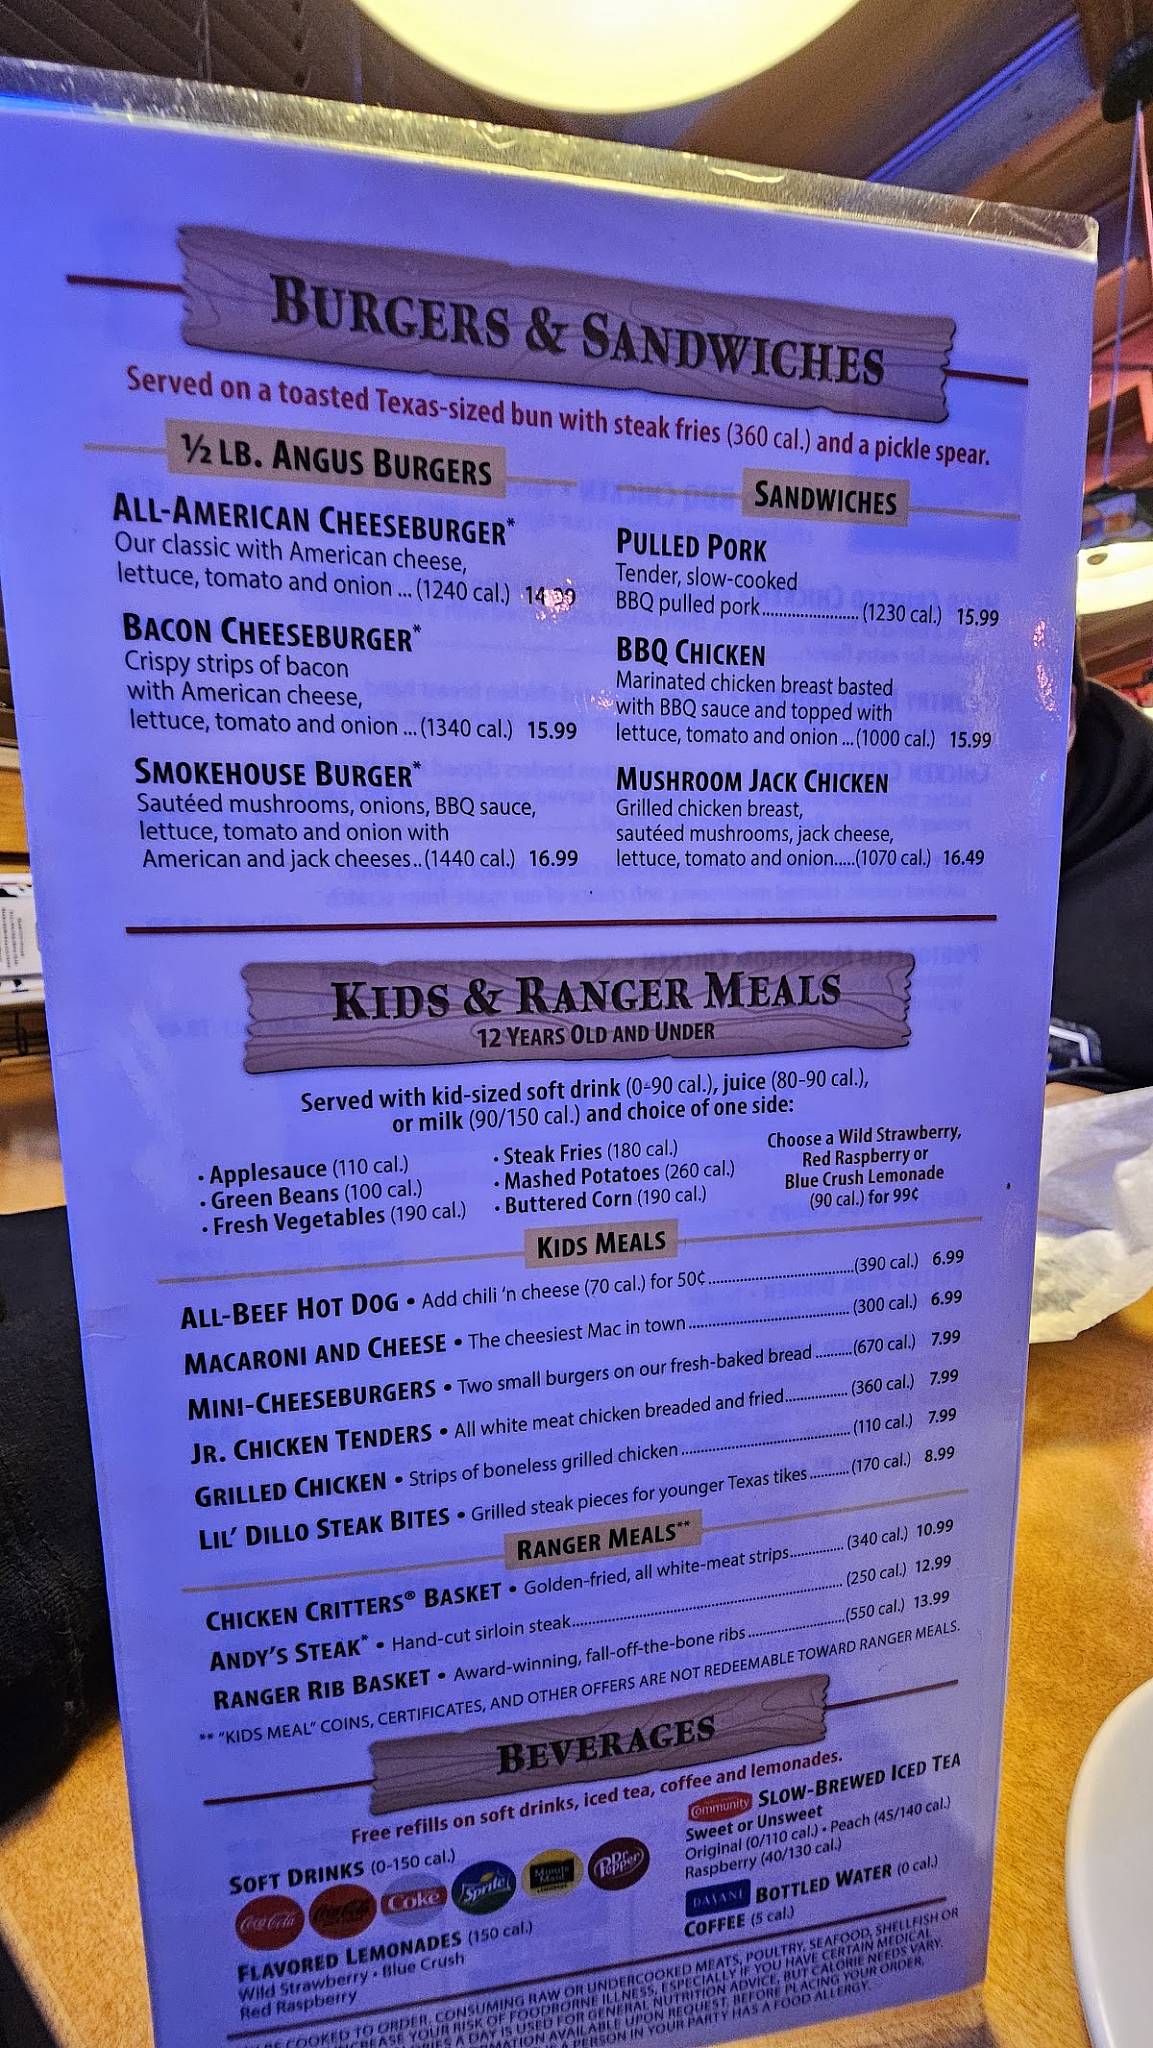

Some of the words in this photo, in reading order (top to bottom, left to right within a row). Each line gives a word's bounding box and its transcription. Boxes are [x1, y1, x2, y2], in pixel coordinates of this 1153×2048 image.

[270, 273, 509, 348] BURGERS
[526, 306, 566, 354] &
[582, 312, 885, 386] SANDWICHES
[127, 366, 212, 396] Served
[221, 380, 250, 400] on
[258, 383, 271, 402] a
[278, 381, 368, 410] toasted
[376, 388, 504, 424] Texas-sized
[512, 401, 552, 428] bun
[559, 408, 607, 433] with
[614, 415, 670, 439] steak
[675, 417, 720, 443] fries
[728, 422, 768, 448] (360
[774, 428, 810, 454] cal.)
[817, 432, 853, 454] and
[859, 439, 869, 455] a
[875, 436, 930, 461] pickle
[936, 445, 989, 467] spear.
[220, 439, 262, 468] LB.
[272, 440, 364, 475] ANGUS
[374, 448, 491, 486] BURGERS
[114, 492, 309, 532] ALL-AMERICAN
[755, 480, 896, 515] SANDWICHES
[618, 528, 699, 558] PULLED
[708, 534, 766, 562] PORK
[616, 563, 681, 588] Tender,
[687, 566, 797, 590] slow-cooked
[617, 590, 653, 612] BBQ
[660, 593, 714, 616] pulled
[863, 602, 905, 623] (1230
[911, 605, 941, 626] cal.)
[958, 608, 999, 626] 15.99
[123, 613, 211, 643] BACON
[618, 636, 668, 666] BBQ
[676, 639, 765, 666] CHICKEN
[617, 670, 705, 691] Marinated
[711, 673, 775, 692] chicken
[781, 674, 833, 694] breast
[838, 676, 892, 696] basted
[135, 757, 306, 786] SMOKEHOUSE
[617, 767, 742, 792] MUSHROOM
[748, 769, 797, 792] JACK
[804, 770, 888, 793] CHICKEN
[138, 793, 222, 812] Sautéed
[230, 793, 354, 816] mushrooms,
[360, 796, 430, 817] onions,
[436, 797, 474, 816] BBQ
[480, 802, 535, 818] sauce,
[331, 981, 449, 1021] KIDS
[464, 977, 501, 1017] &
[516, 976, 693, 1015] RANGER
[704, 971, 842, 1009] MEALS
[477, 1027, 501, 1048] 12
[507, 1025, 565, 1046] YEARS
[571, 1023, 607, 1045] OLD
[612, 1023, 649, 1043] AND
[655, 1021, 715, 1042] UNDER
[504, 1145, 555, 1165] Steak
[561, 1144, 602, 1162] Fries
[608, 1142, 641, 1161] (180
[646, 1139, 677, 1157] cal.)
[210, 1163, 326, 1184] Applesauce
[333, 1159, 368, 1178] (110
[374, 1155, 408, 1174] cal.)
[810, 1193, 832, 1210] (90
[836, 1190, 864, 1207] cal.)
[868, 1189, 889, 1204] for
[538, 1236, 587, 1259] KIDS
[596, 1231, 666, 1254] MEALS
[185, 1346, 306, 1375] MACARONI
[315, 1343, 360, 1364] AND
[368, 1334, 446, 1358] CHEESE
[468, 1332, 500, 1349] The
[505, 1325, 582, 1346] cheesiest
[588, 1322, 621, 1338] Mac
[626, 1320, 639, 1334] in
[854, 1297, 884, 1316] (300
[889, 1294, 917, 1310] cal.)
[932, 1290, 962, 1305] 6.99
[189, 1380, 436, 1420] MINI-CHEESEBURGERS
[457, 1378, 492, 1394] Two
[498, 1370, 540, 1390] small
[546, 1369, 609, 1387] burgers
[614, 1366, 634, 1378] on
[640, 1363, 666, 1376] our
[671, 1349, 763, 1373] fresh-baked
[854, 1338, 883, 1356] (670
[888, 1334, 915, 1350] cal.)
[932, 1330, 960, 1346] 7.99
[518, 1534, 600, 1560] RANGER
[393, 1628, 470, 1651] Hand-cut
[476, 1622, 524, 1640] sirloin
[847, 1568, 876, 1587] (250
[880, 1562, 906, 1579] cal.)
[916, 1555, 951, 1572] 12.99
[497, 1715, 716, 1775] BEVERAGES
[759, 1770, 885, 1807] SLOW-BREWED
[892, 1761, 926, 1781] ICED
[932, 1753, 960, 1772] TEA
[352, 1828, 390, 1844] Free
[396, 1816, 448, 1838] refills
[453, 1815, 474, 1828] on
[480, 1805, 515, 1824] soft
[520, 1797, 579, 1817] drinks,
[584, 1787, 618, 1807] iced
[623, 1786, 655, 1800] tea,
[660, 1774, 712, 1793] coffee
[716, 1765, 746, 1784] and
[751, 1751, 842, 1778] lemonades.
[690, 1796, 751, 1820] Community
[686, 1822, 733, 1842] Sweet
[738, 1820, 754, 1832] or
[758, 1805, 823, 1828] Unsweet
[230, 1873, 280, 1895] SOFT
[288, 1861, 364, 1888] DRINKS
[372, 1855, 419, 1875] (0-150
[424, 1848, 455, 1866] cal.)
[594, 1850, 643, 1878] Pepper
[609, 1848, 630, 1863] Dr
[461, 1876, 512, 1902] Sprite
[756, 1877, 830, 1904] BOTTLED
[836, 1864, 892, 1888] WATER
[898, 1862, 909, 1876] (0
[913, 1854, 937, 1871] cal.)
[387, 1890, 440, 1910] Coke
[238, 1953, 338, 1983] FLAVORED
[346, 1931, 461, 1965] LEMONADES
[468, 1928, 498, 1946] (150
[503, 1920, 532, 1937] cal.)
